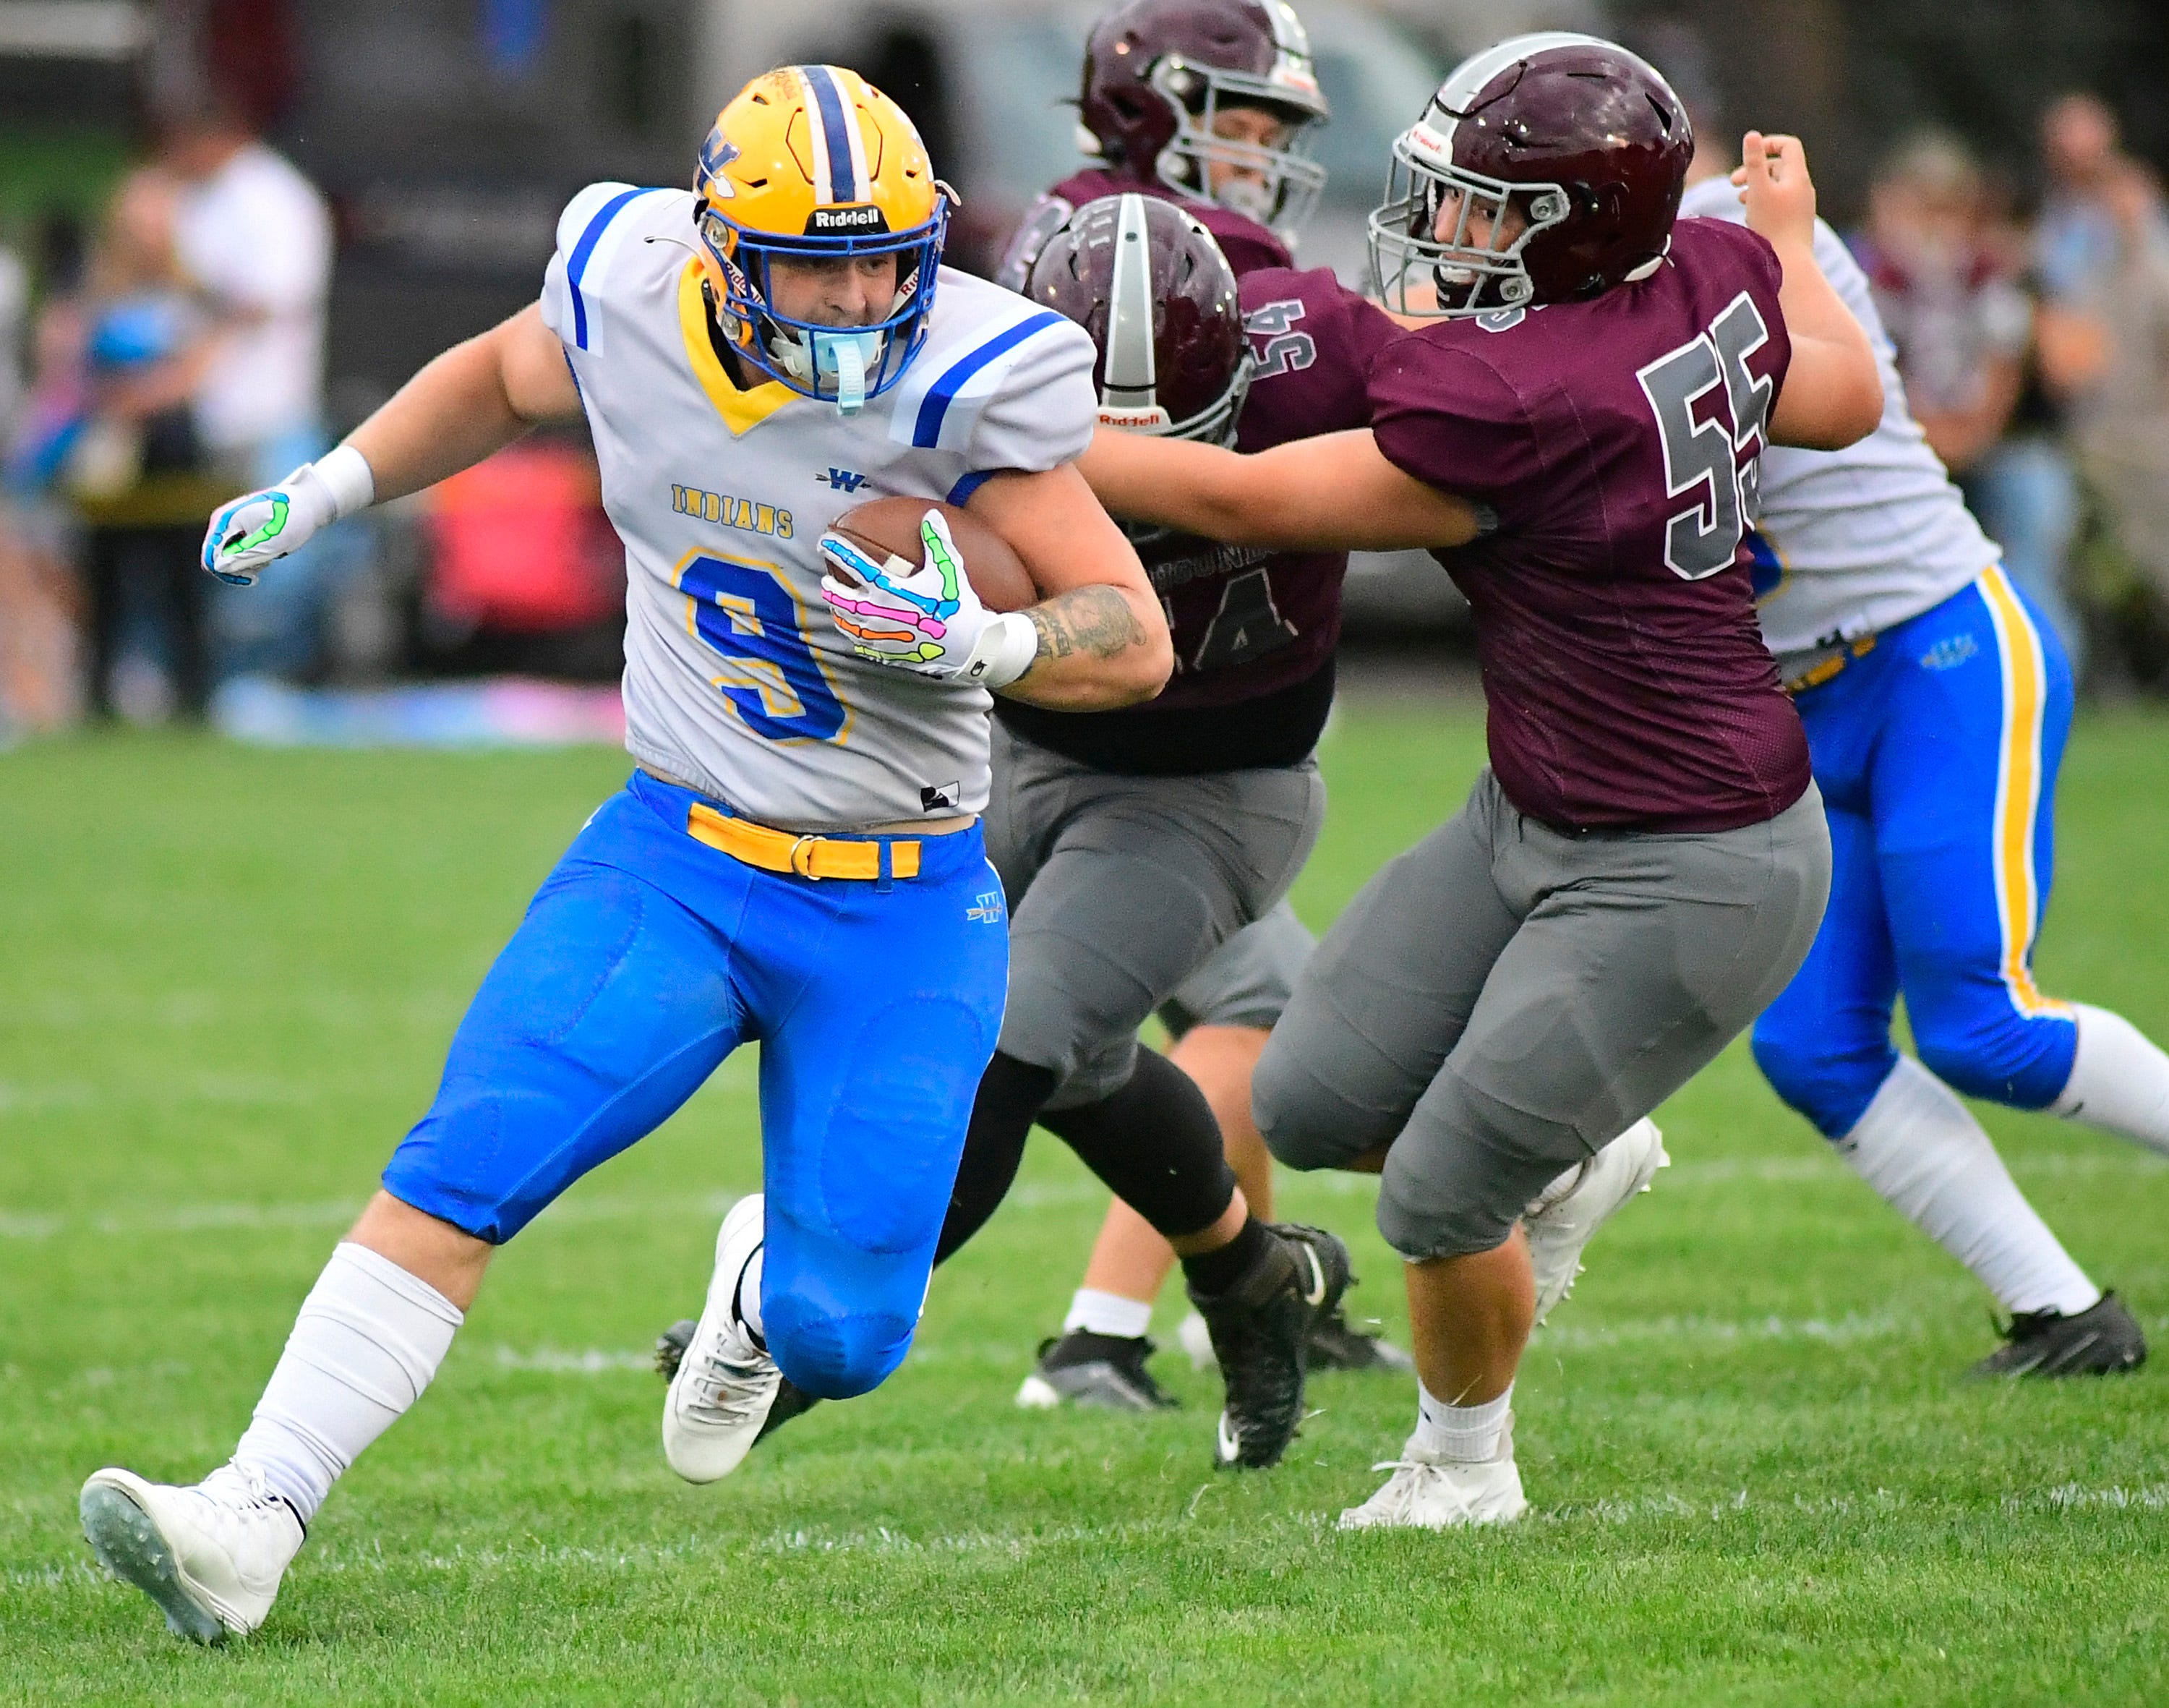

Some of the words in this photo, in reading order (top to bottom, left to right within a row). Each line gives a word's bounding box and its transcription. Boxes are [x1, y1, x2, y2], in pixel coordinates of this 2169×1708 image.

[816, 208, 879, 227] Riddell
[1242, 297, 1317, 382] 54
[1099, 414, 1160, 427] Riddell
[1635, 290, 1773, 582] 55
[828, 467, 865, 493] W
[671, 484, 794, 539] INDIANS
[669, 546, 855, 747] 9
